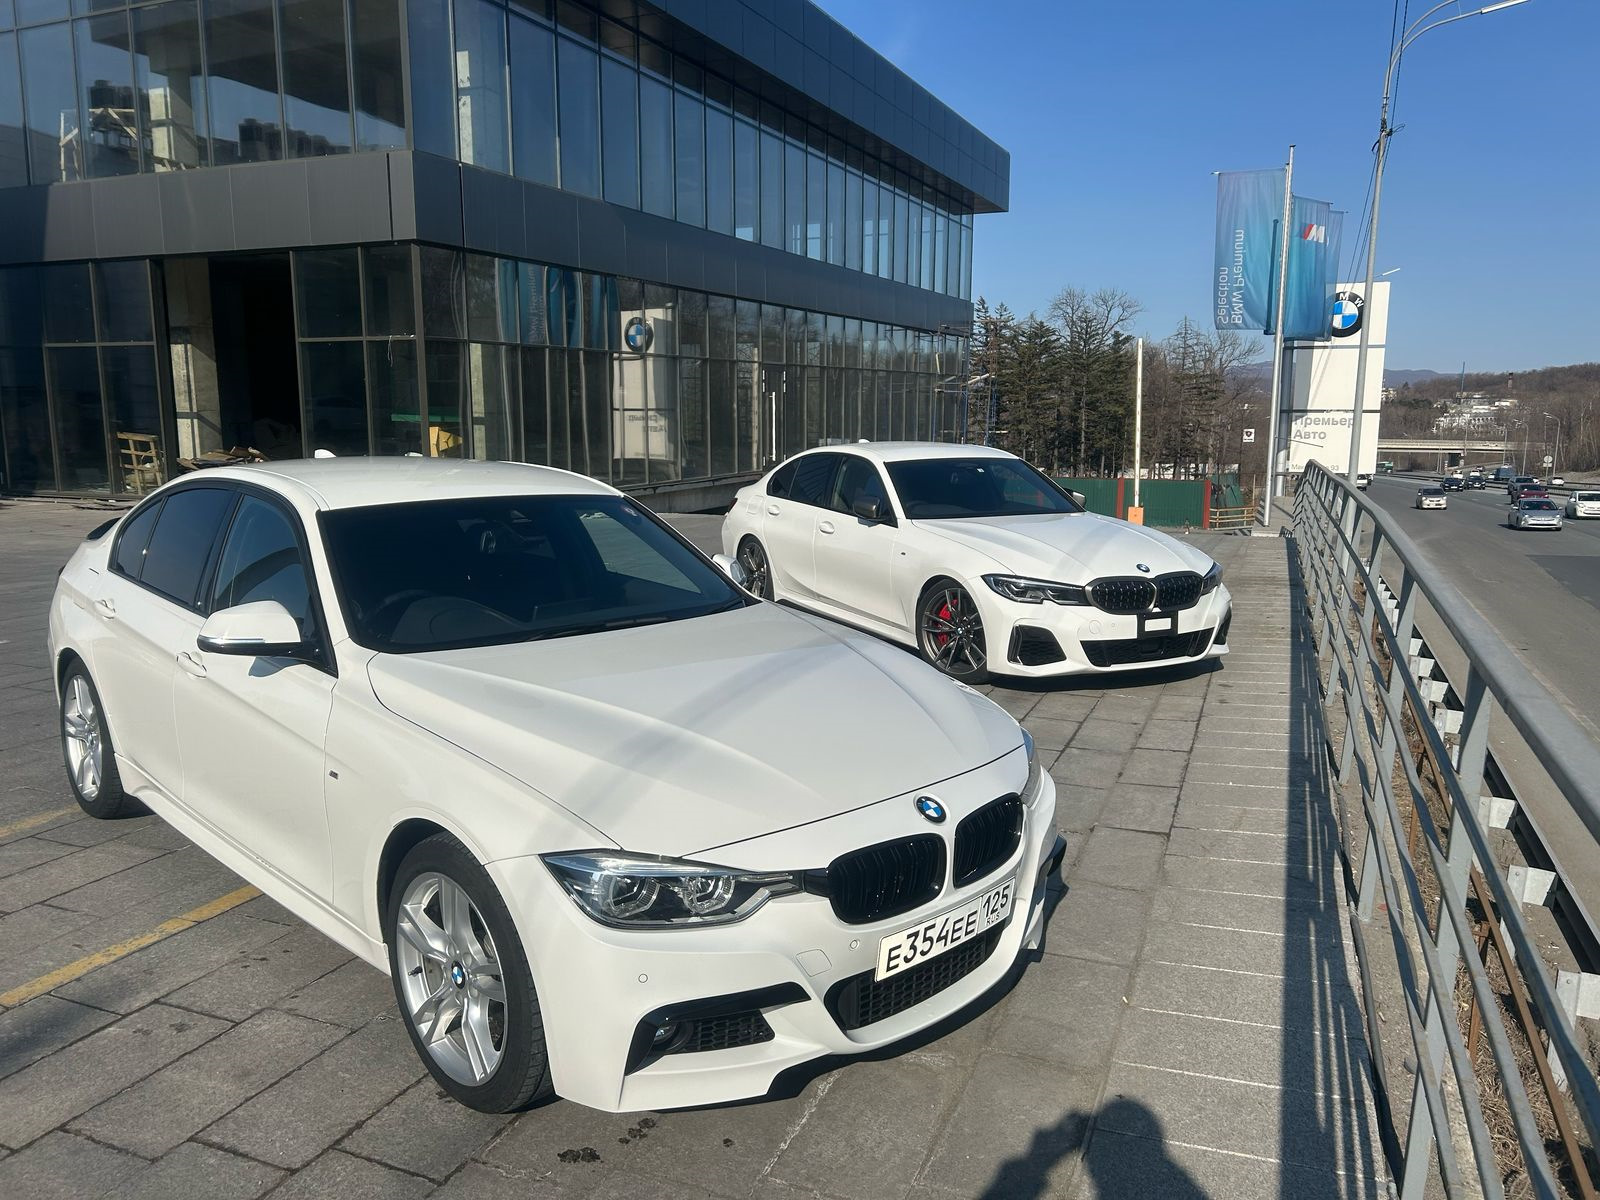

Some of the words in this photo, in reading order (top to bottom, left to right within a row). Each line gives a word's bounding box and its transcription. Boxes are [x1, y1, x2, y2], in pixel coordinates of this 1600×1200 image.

[1293, 429, 1327, 440] Авто
[886, 909, 978, 973] E354EE
[982, 883, 1011, 918] 125
